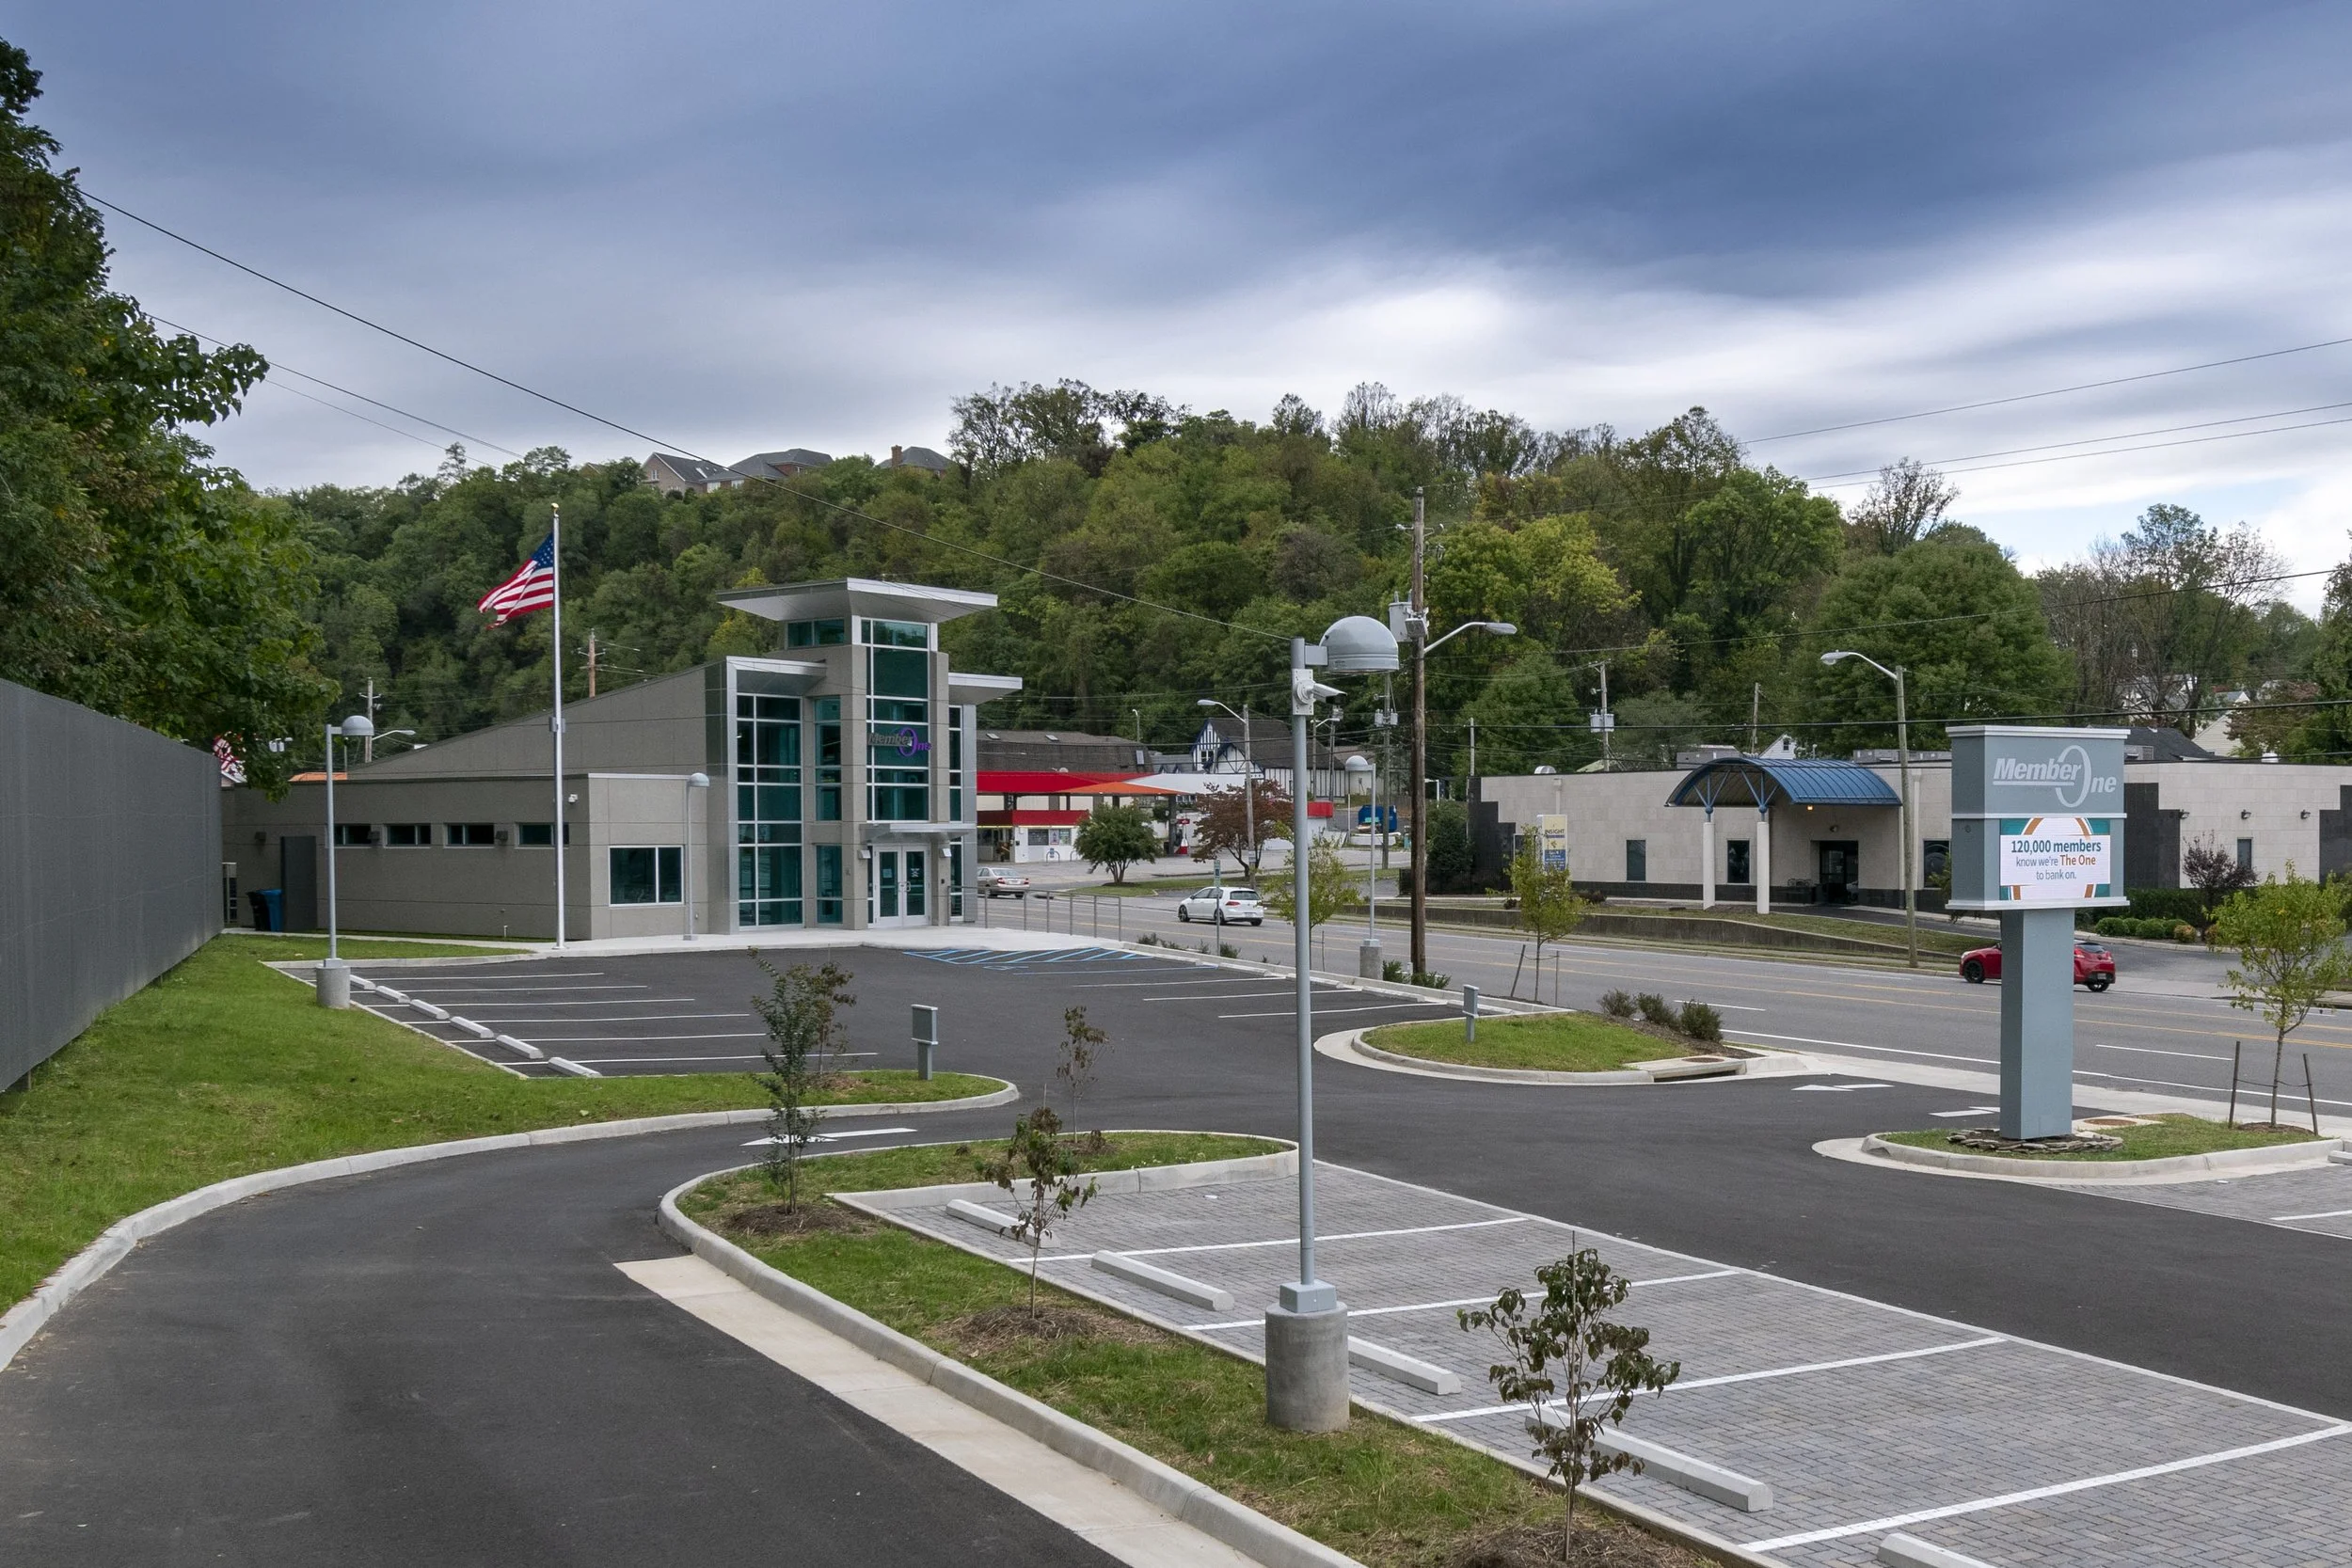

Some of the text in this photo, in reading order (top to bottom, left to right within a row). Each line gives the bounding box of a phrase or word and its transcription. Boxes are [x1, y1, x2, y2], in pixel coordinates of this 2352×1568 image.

[867, 733, 914, 745] Member
[1994, 744, 2117, 807] Member One
[2010, 838, 2102, 855] 120,000 members
[2015, 854, 2096, 867] know we're The One
[2036, 869, 2077, 880] to bank on.
